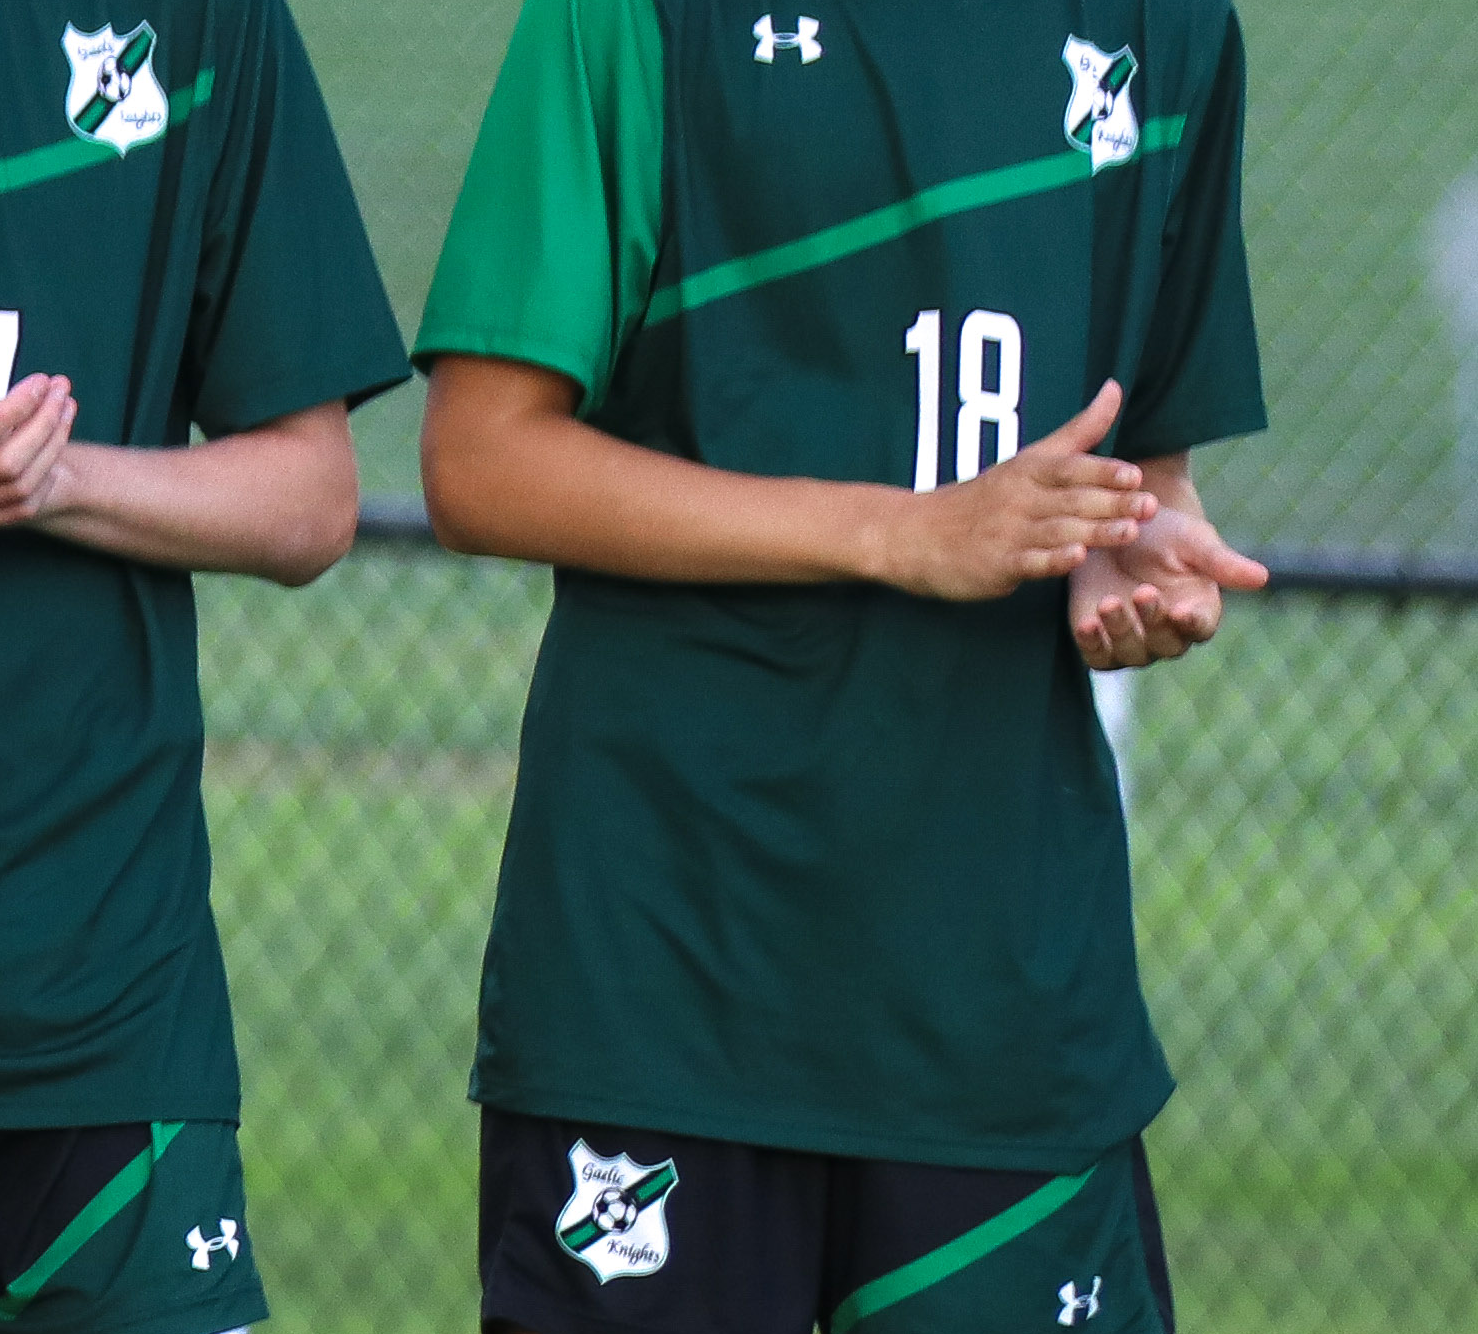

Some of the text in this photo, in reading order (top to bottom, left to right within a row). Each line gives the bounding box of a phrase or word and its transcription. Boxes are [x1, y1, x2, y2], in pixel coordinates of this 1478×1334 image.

[905, 309, 1021, 494] 18
[581, 1161, 625, 1186] Gaelic
[607, 1238, 660, 1266] Knights
